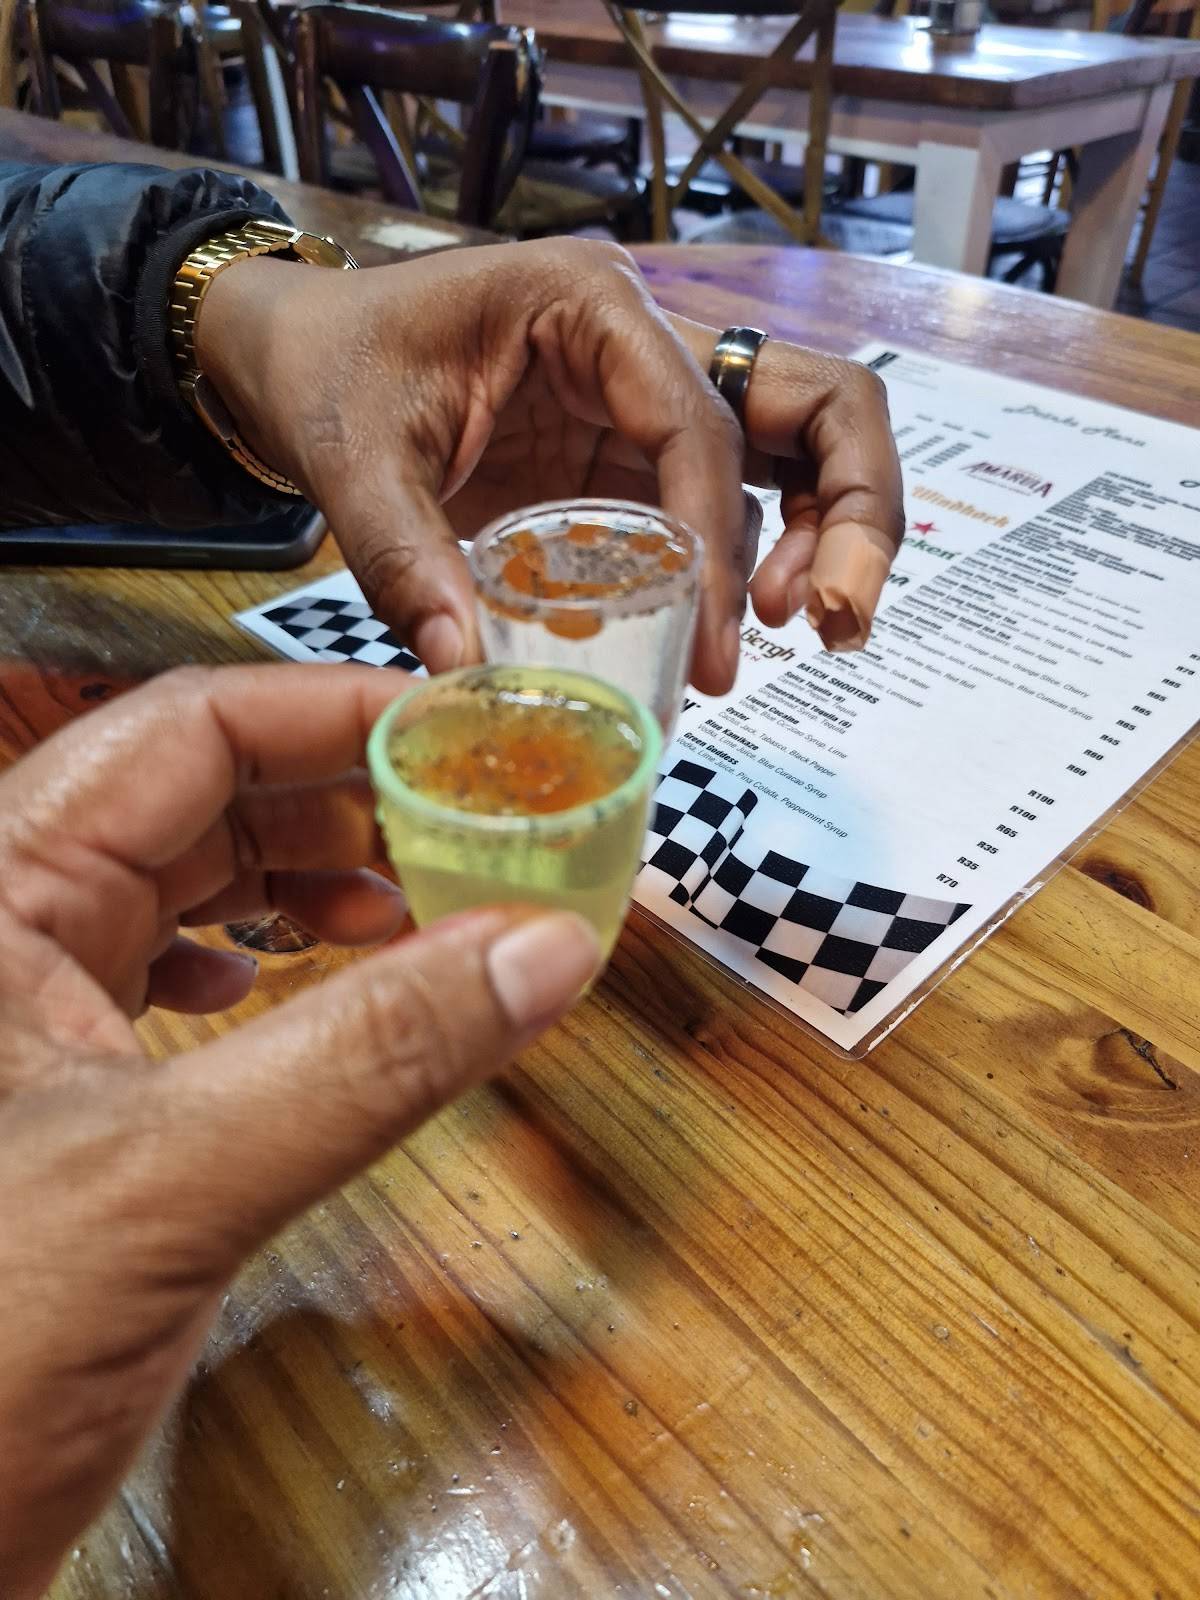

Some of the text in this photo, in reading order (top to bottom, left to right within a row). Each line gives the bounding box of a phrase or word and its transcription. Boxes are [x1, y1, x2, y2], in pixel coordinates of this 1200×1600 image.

[964, 461, 1053, 498] AMARULA
[797, 663, 879, 704] BATCH SHOOTERS
[726, 707, 749, 721] Oyster
[745, 695, 799, 724] Liquid Cocaine
[705, 719, 758, 750] Blue Kamikaze
[1100, 734, 1120, 746] R45
[684, 732, 739, 764] Green Goddess
[828, 746, 847, 758] Lime
[1083, 749, 1104, 761] R60
[719, 736, 736, 748] Lime
[758, 757, 775, 769] Blue
[805, 783, 827, 798] Syrup
[790, 749, 809, 762] Black
[810, 760, 837, 777] Pepper
[1066, 764, 1087, 776] R60
[697, 750, 715, 762] Lime
[781, 797, 825, 824] Peppermint
[824, 821, 849, 837] Syrup
[1027, 789, 1055, 805] R100
[1009, 805, 1037, 821] R100
[996, 824, 1018, 838] R65
[977, 841, 999, 854] R35
[957, 856, 979, 870] R35
[936, 873, 959, 888] R70
